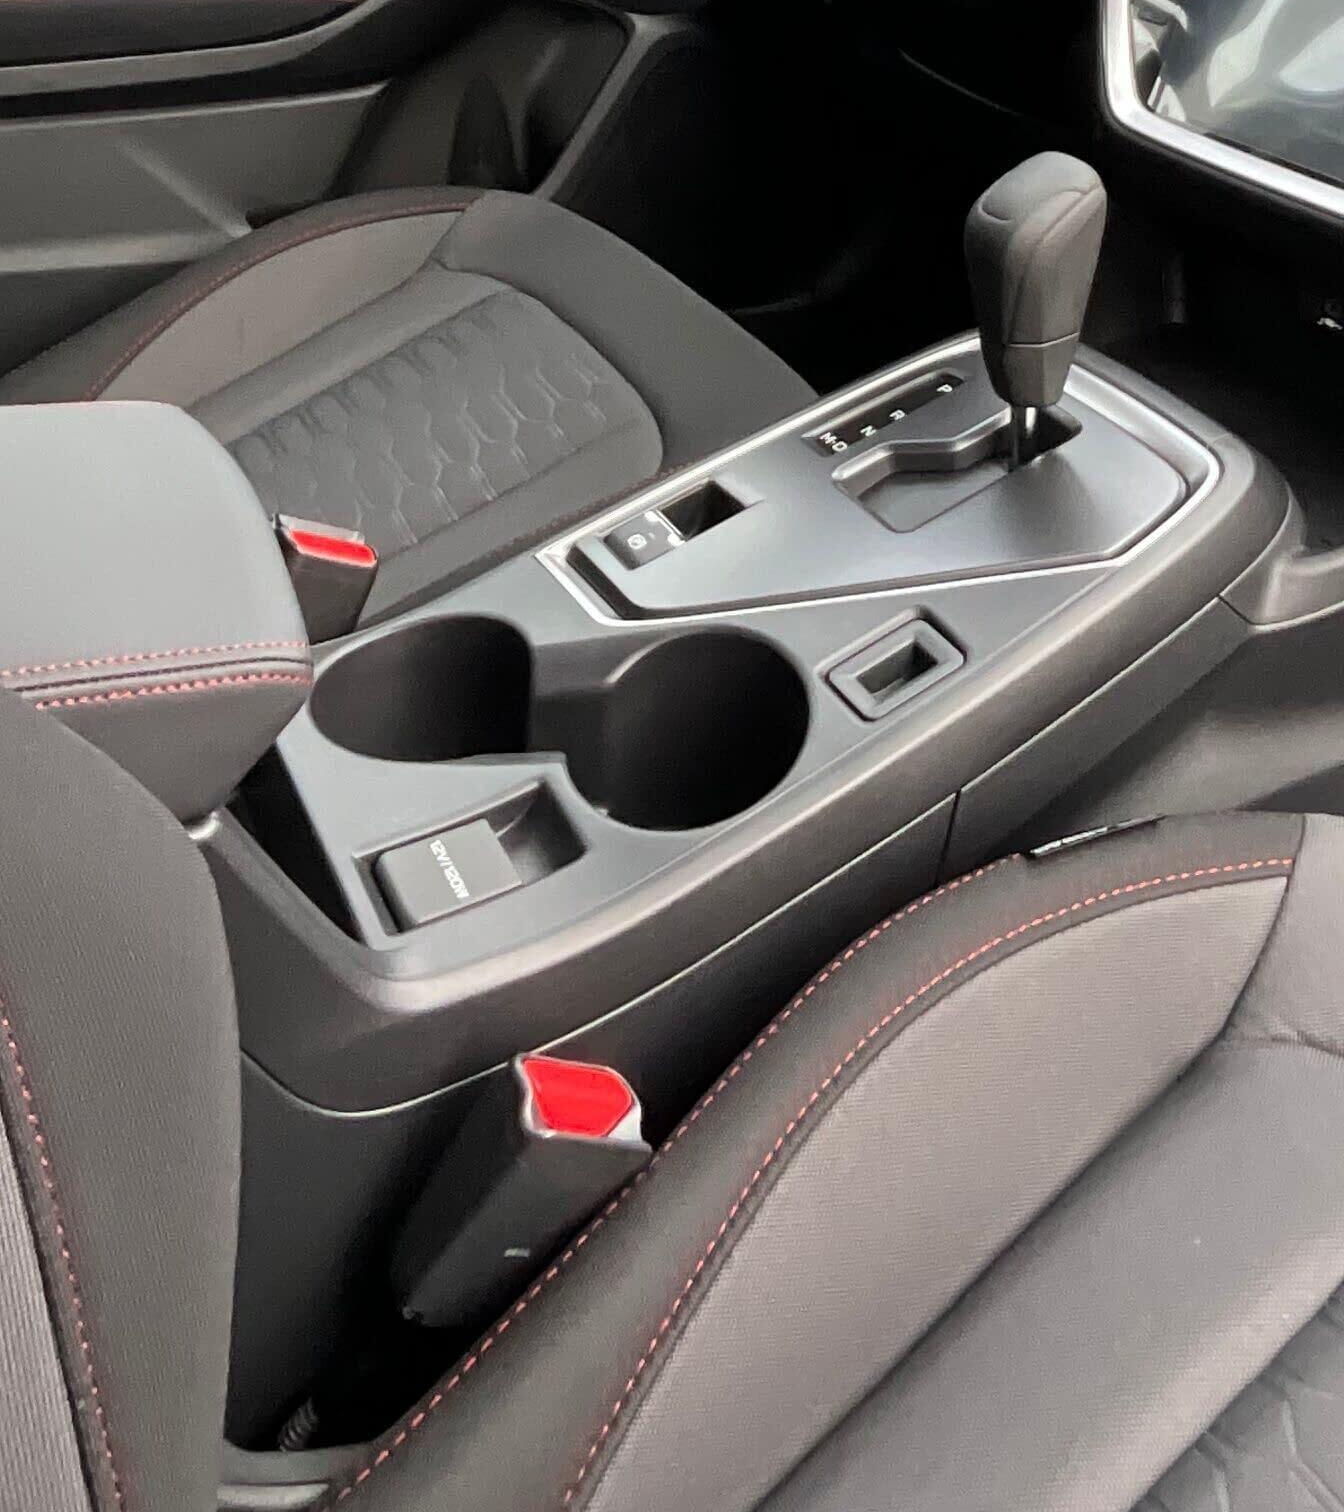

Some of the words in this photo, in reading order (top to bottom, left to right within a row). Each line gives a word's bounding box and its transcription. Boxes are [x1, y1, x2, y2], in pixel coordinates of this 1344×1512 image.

[937, 384, 953, 393] P
[890, 409, 906, 421] R
[860, 425, 877, 437] N
